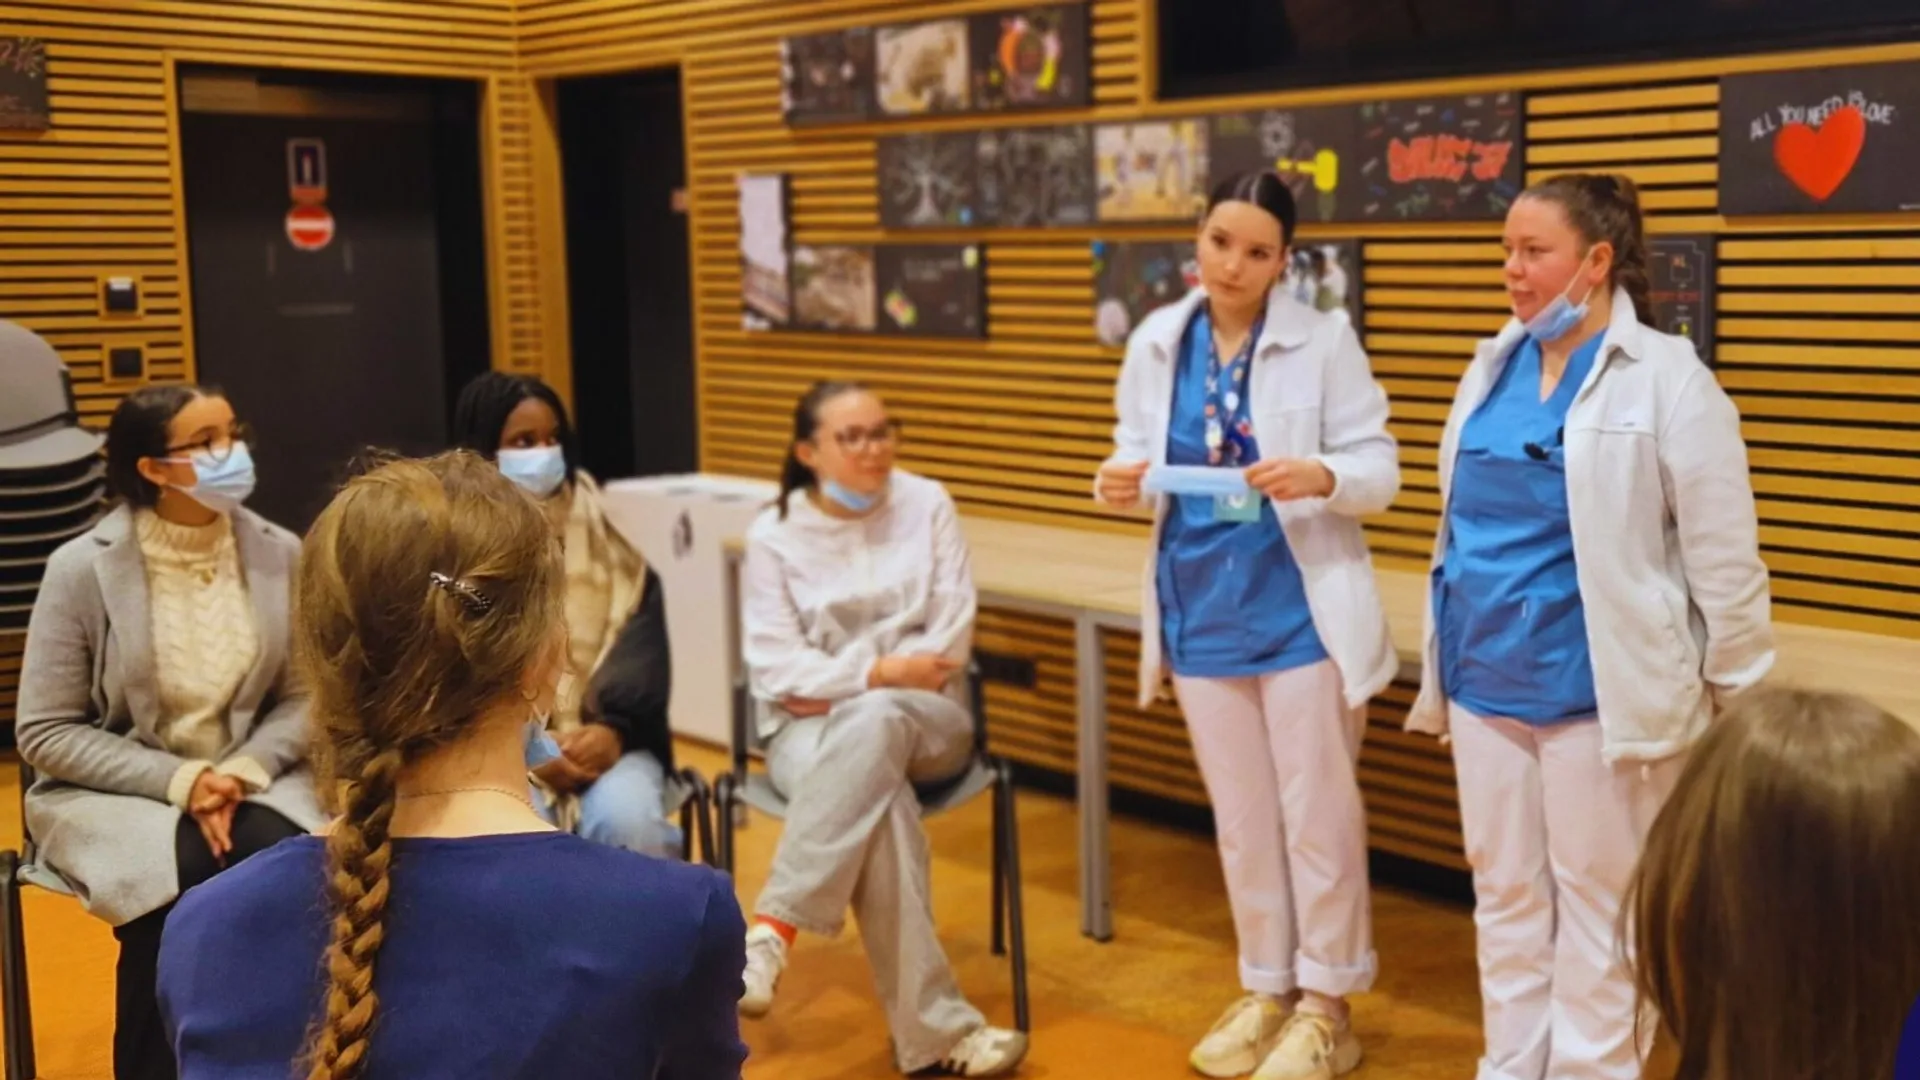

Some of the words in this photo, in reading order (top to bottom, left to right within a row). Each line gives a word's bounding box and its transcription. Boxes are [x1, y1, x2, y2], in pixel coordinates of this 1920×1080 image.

[1750, 112, 1775, 140] ALL
[1779, 104, 1805, 124] YOU
[1806, 95, 1844, 126] NEED
[1863, 98, 1895, 124] LOVE
